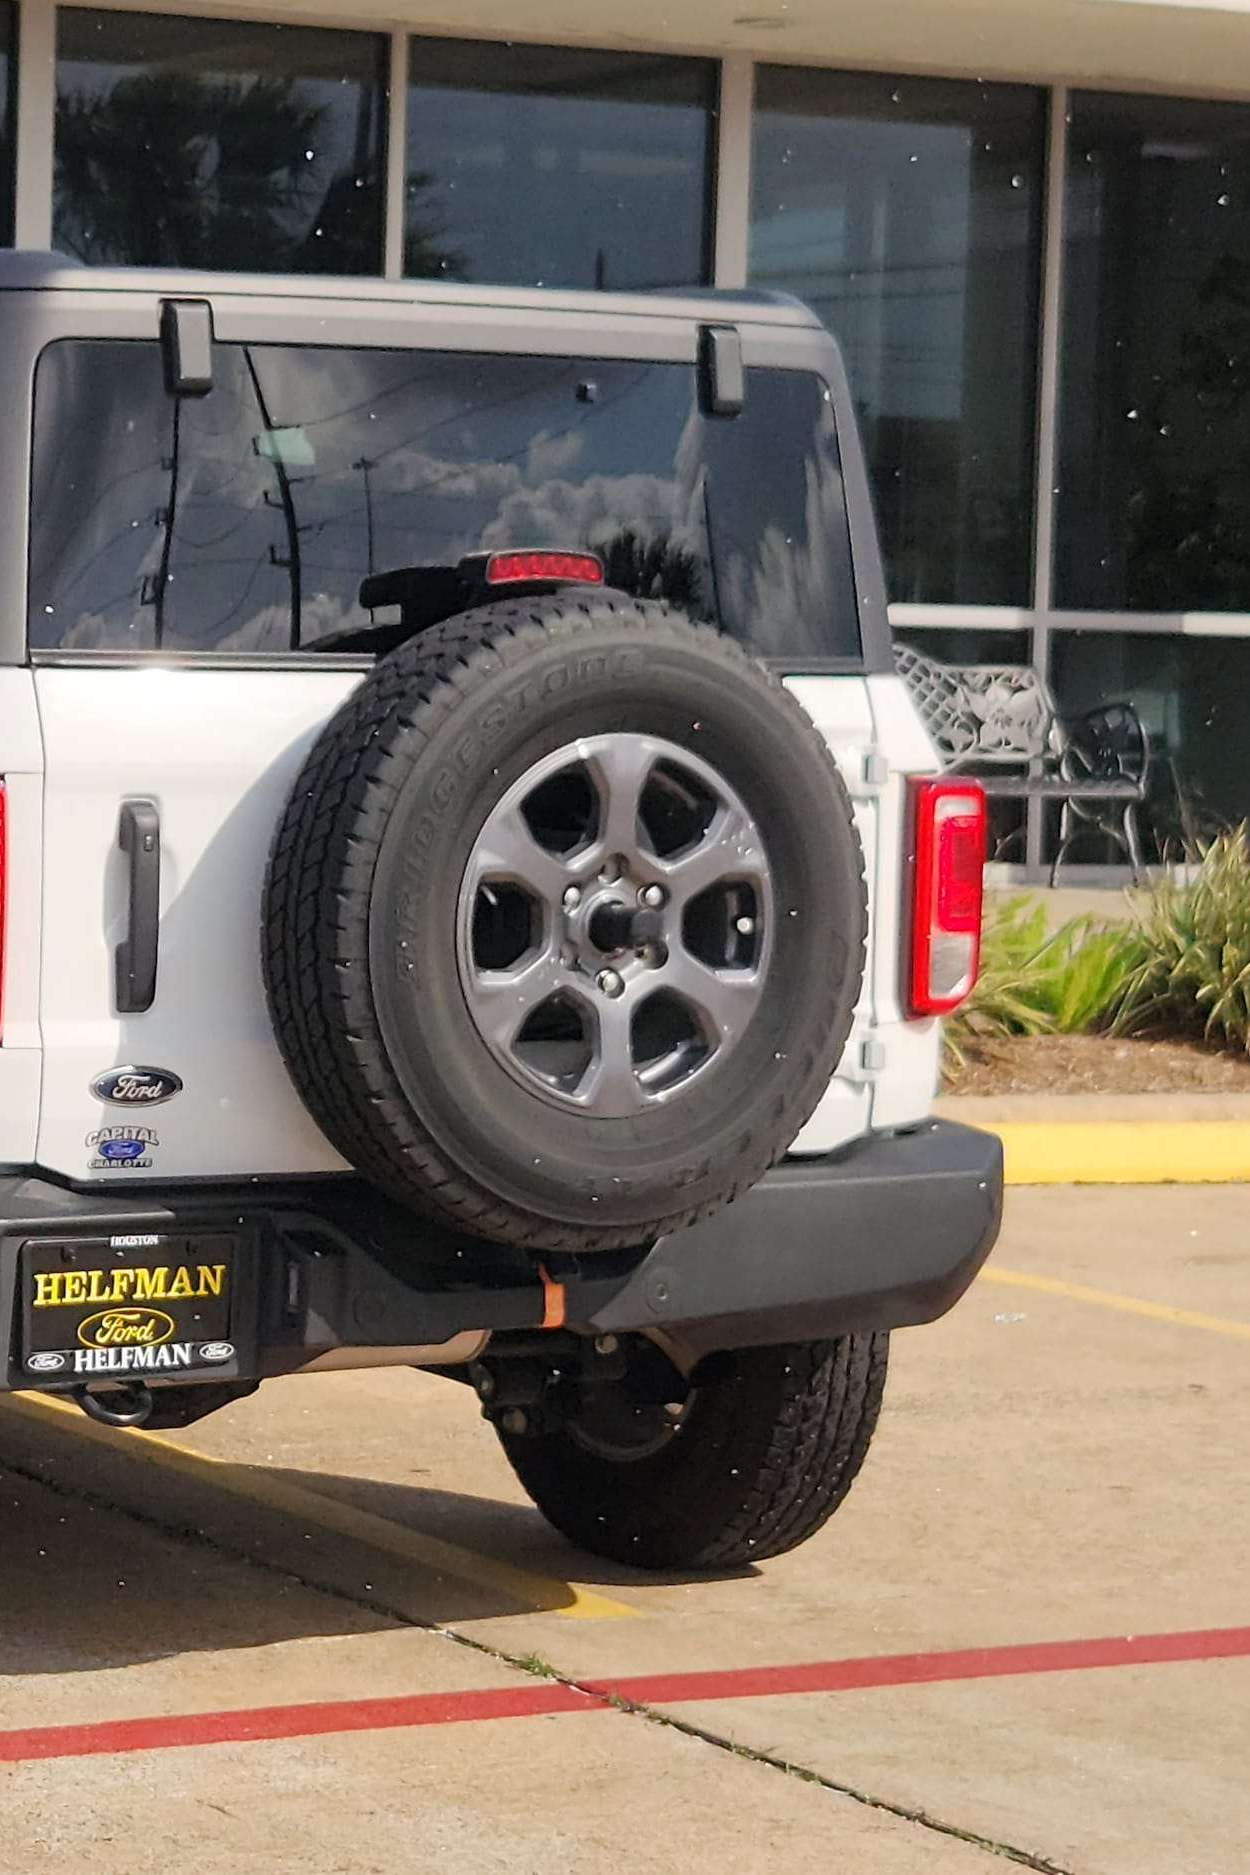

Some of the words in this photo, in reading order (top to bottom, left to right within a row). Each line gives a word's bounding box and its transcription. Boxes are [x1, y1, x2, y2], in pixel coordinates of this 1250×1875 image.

[85, 1126, 159, 1147] CAPITAL
[110, 1235, 159, 1247] HOUSTON
[32, 1264, 227, 1306] HELFMAN
[95, 1312, 155, 1343] Ford
[73, 1342, 193, 1373] HELFMAN
